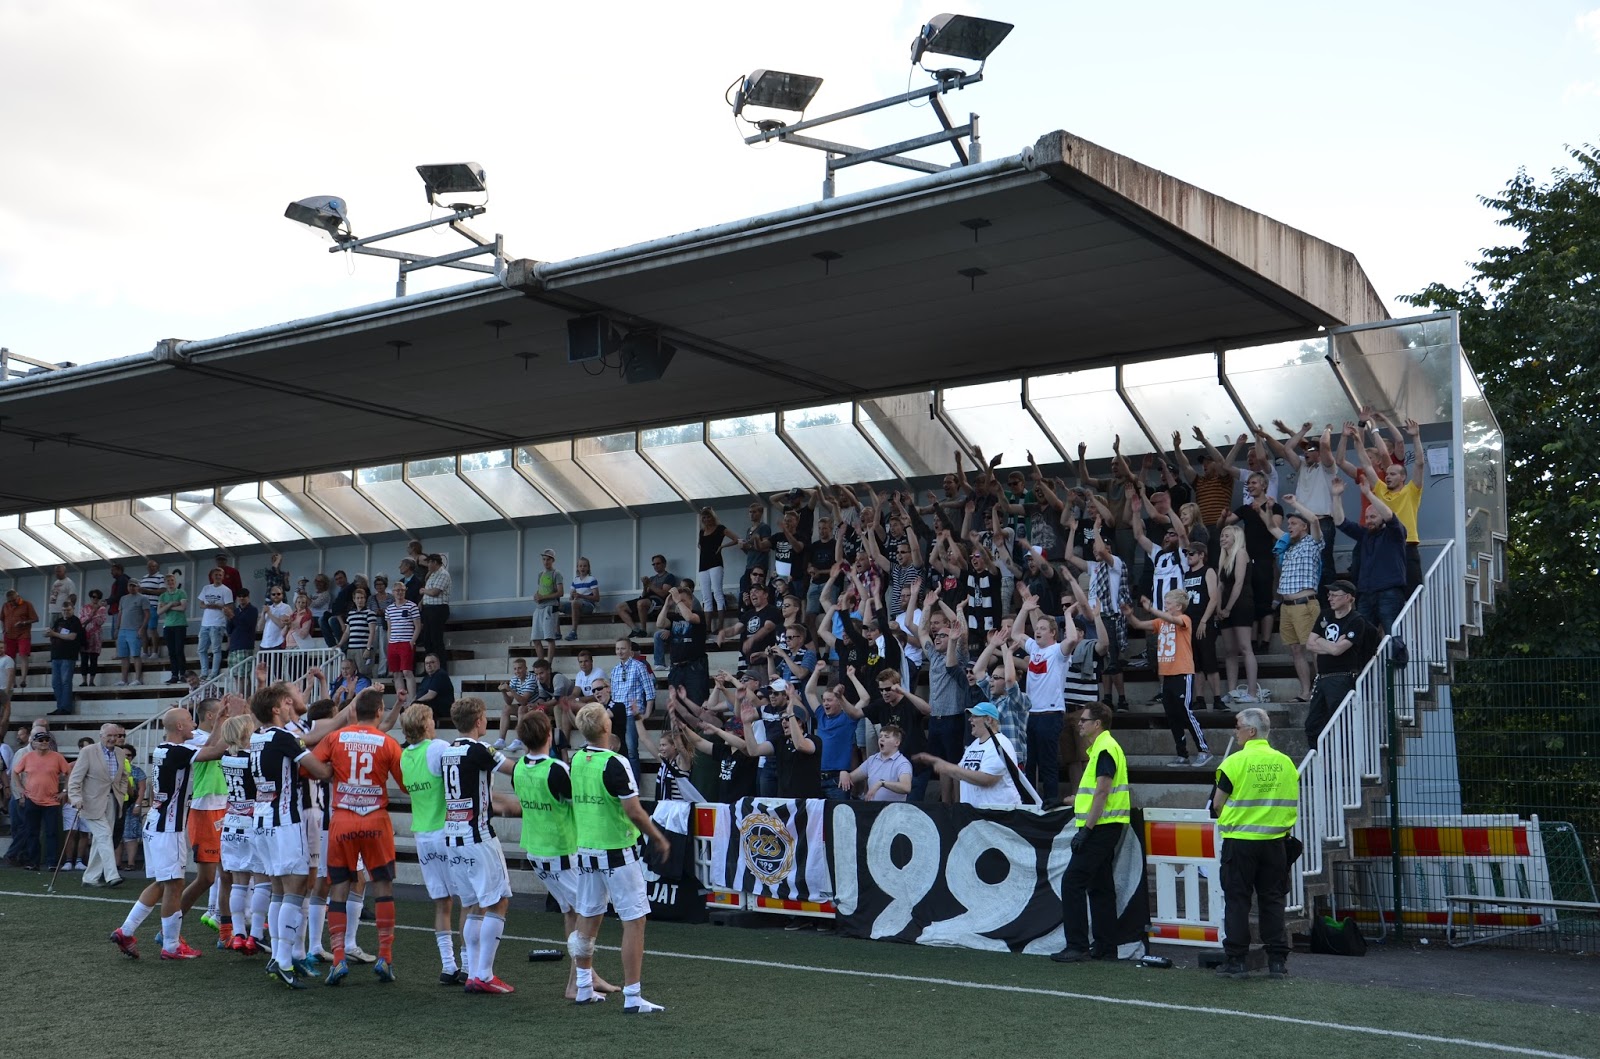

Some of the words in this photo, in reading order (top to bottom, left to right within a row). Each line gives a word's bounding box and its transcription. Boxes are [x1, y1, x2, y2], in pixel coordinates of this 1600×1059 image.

[344, 742, 377, 754] FORSMAN
[347, 751, 374, 786] 12
[443, 765, 462, 799] 19
[648, 882, 679, 905] JAT
